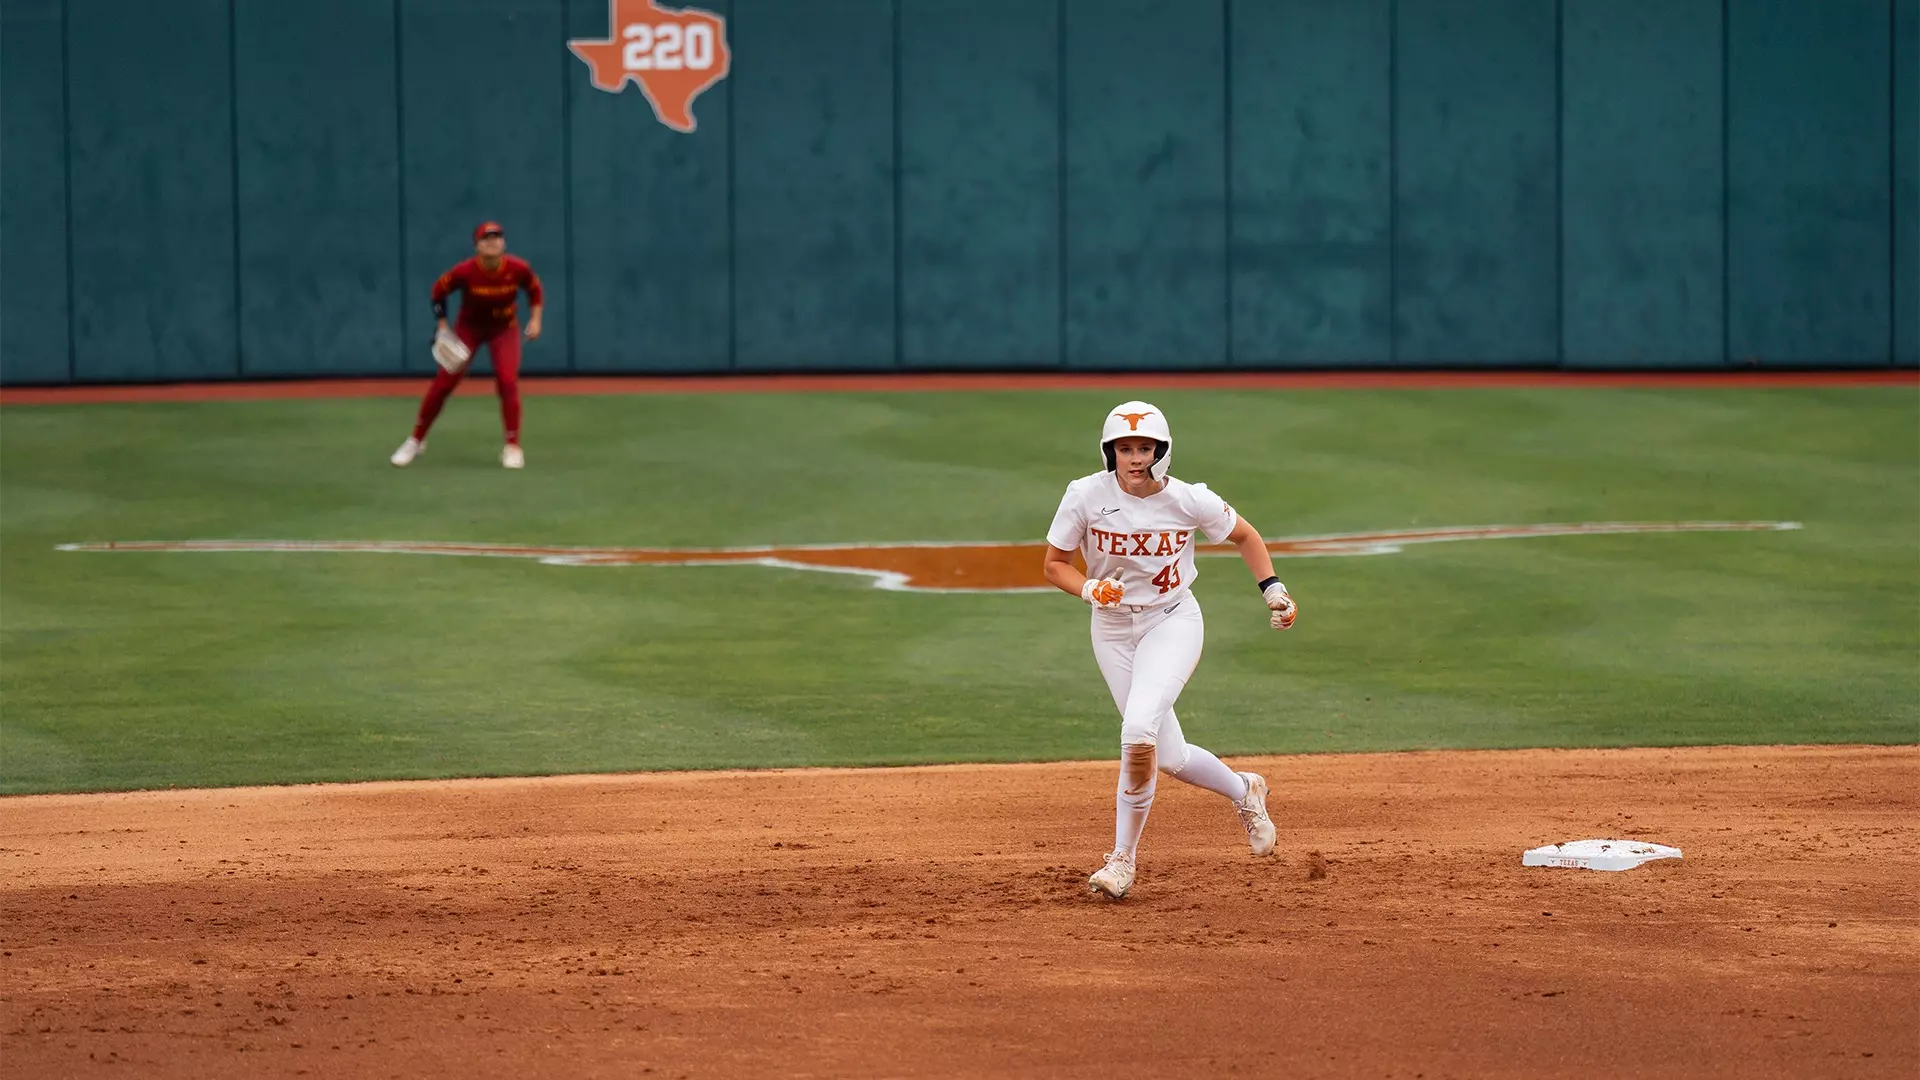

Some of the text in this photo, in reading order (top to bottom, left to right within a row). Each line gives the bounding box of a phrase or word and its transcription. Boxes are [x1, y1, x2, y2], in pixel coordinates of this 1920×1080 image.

[622, 22, 714, 70] 220
[1091, 528, 1188, 556] TEXAS
[1559, 859, 1579, 867] TEXAS
